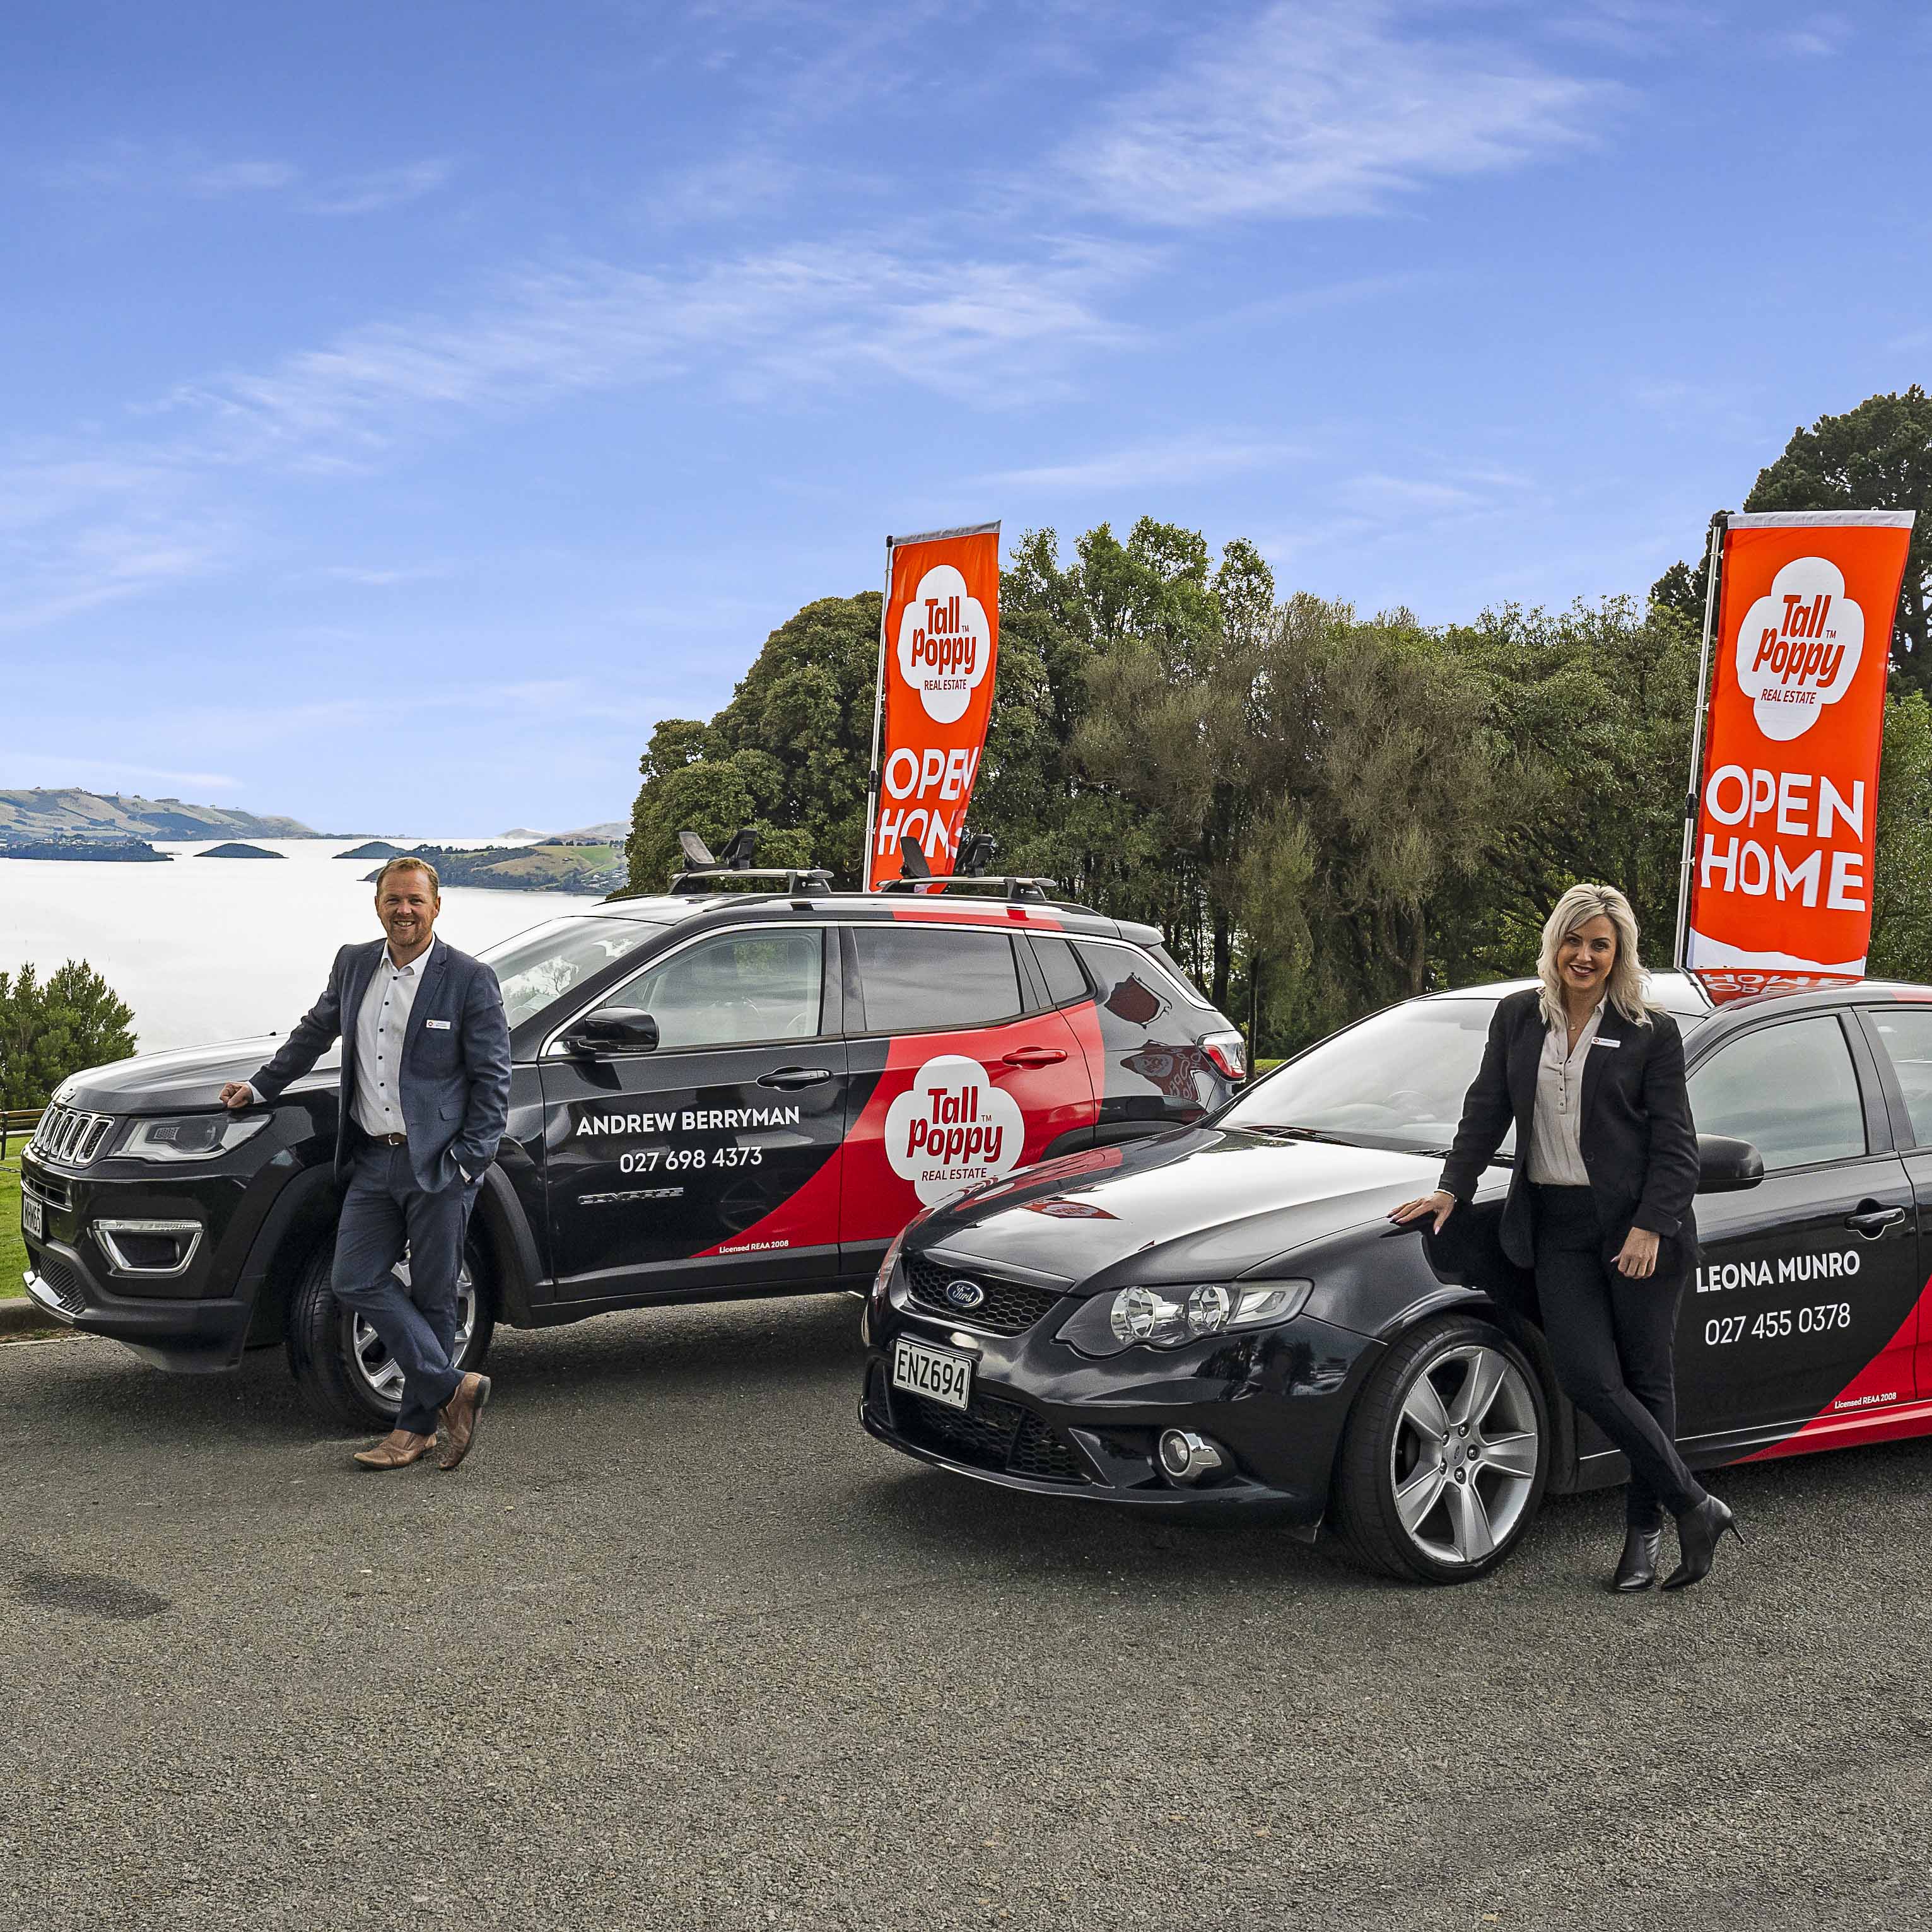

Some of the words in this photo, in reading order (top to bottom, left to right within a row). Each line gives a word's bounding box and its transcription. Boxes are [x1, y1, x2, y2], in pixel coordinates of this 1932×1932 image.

[925, 595, 960, 635] Tall
[1781, 594, 1832, 638] Tall
[1826, 629, 1837, 638] TM
[924, 679, 942, 691] REAL
[944, 679, 967, 689] ESTATE
[1760, 688, 1781, 702] REAL
[1783, 690, 1817, 705] ESTATE
[1706, 764, 1865, 843] OPEN
[1701, 833, 1866, 911] HOME
[928, 1086, 978, 1125] Tall
[576, 1111, 677, 1136] ANDREW
[682, 1106, 800, 1131] BERRYMAN
[619, 1151, 660, 1173] 027
[665, 1149, 706, 1171] 698
[711, 1145, 762, 1167] 4373
[922, 1170, 948, 1181] REAL
[949, 1168, 987, 1180] ESTATE
[719, 1243, 749, 1253] Licensed
[751, 1242, 770, 1250] REAA
[771, 1239, 789, 1248] 2008
[1695, 1260, 1774, 1293] LEONA
[1777, 1250, 1860, 1284] MUNRO
[952, 1284, 973, 1303] Ford
[1705, 1315, 1747, 1345] 027
[1751, 1310, 1792, 1339] 455
[1798, 1303, 1851, 1333] 0378
[896, 1349, 965, 1400] ENZ694
[1834, 1397, 1862, 1409] Licensed
[1862, 1395, 1880, 1405] REAA
[1880, 1391, 1897, 1402] 2008
